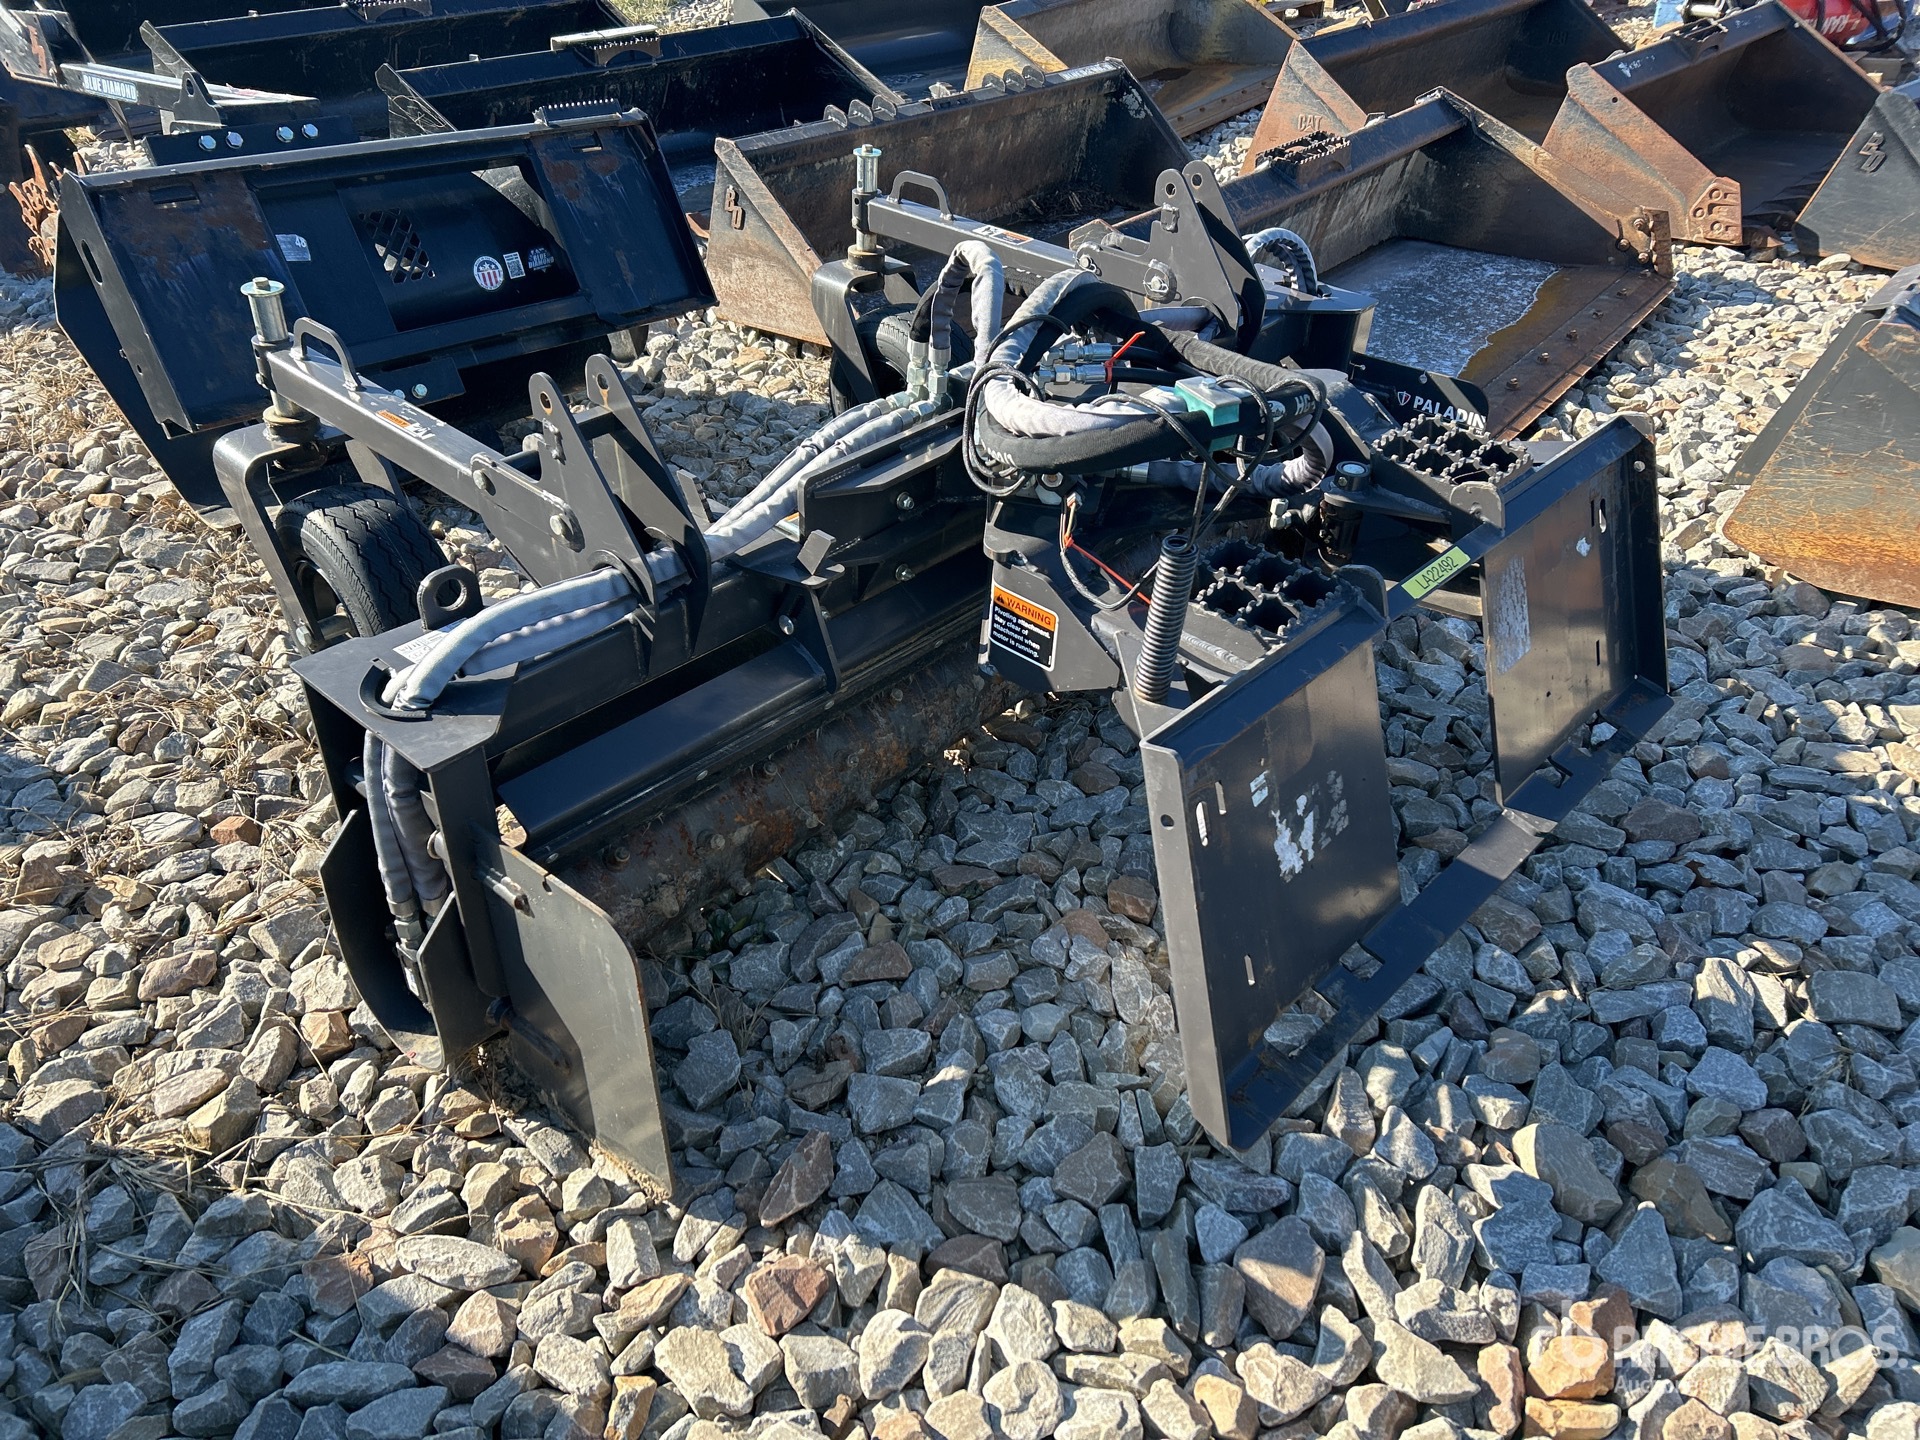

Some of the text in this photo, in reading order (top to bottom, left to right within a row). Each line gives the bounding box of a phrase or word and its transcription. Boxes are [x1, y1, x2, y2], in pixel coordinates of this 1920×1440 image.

[83, 74, 136, 100] BLUE DIAMOND
[1297, 113, 1323, 132] CAT
[528, 256, 554, 269] DIAMOND
[532, 252, 546, 263] BLUE
[1413, 395, 1487, 429] PALADIN
[1414, 556, 1459, 590] LA22492
[994, 606, 1050, 639] Pivoting attachment.
[994, 614, 1006, 626] Stay
[1006, 621, 1021, 632] clear
[1007, 597, 1051, 626] WARNING
[993, 622, 1040, 650] attachment when
[993, 630, 1039, 658] motor is running.
